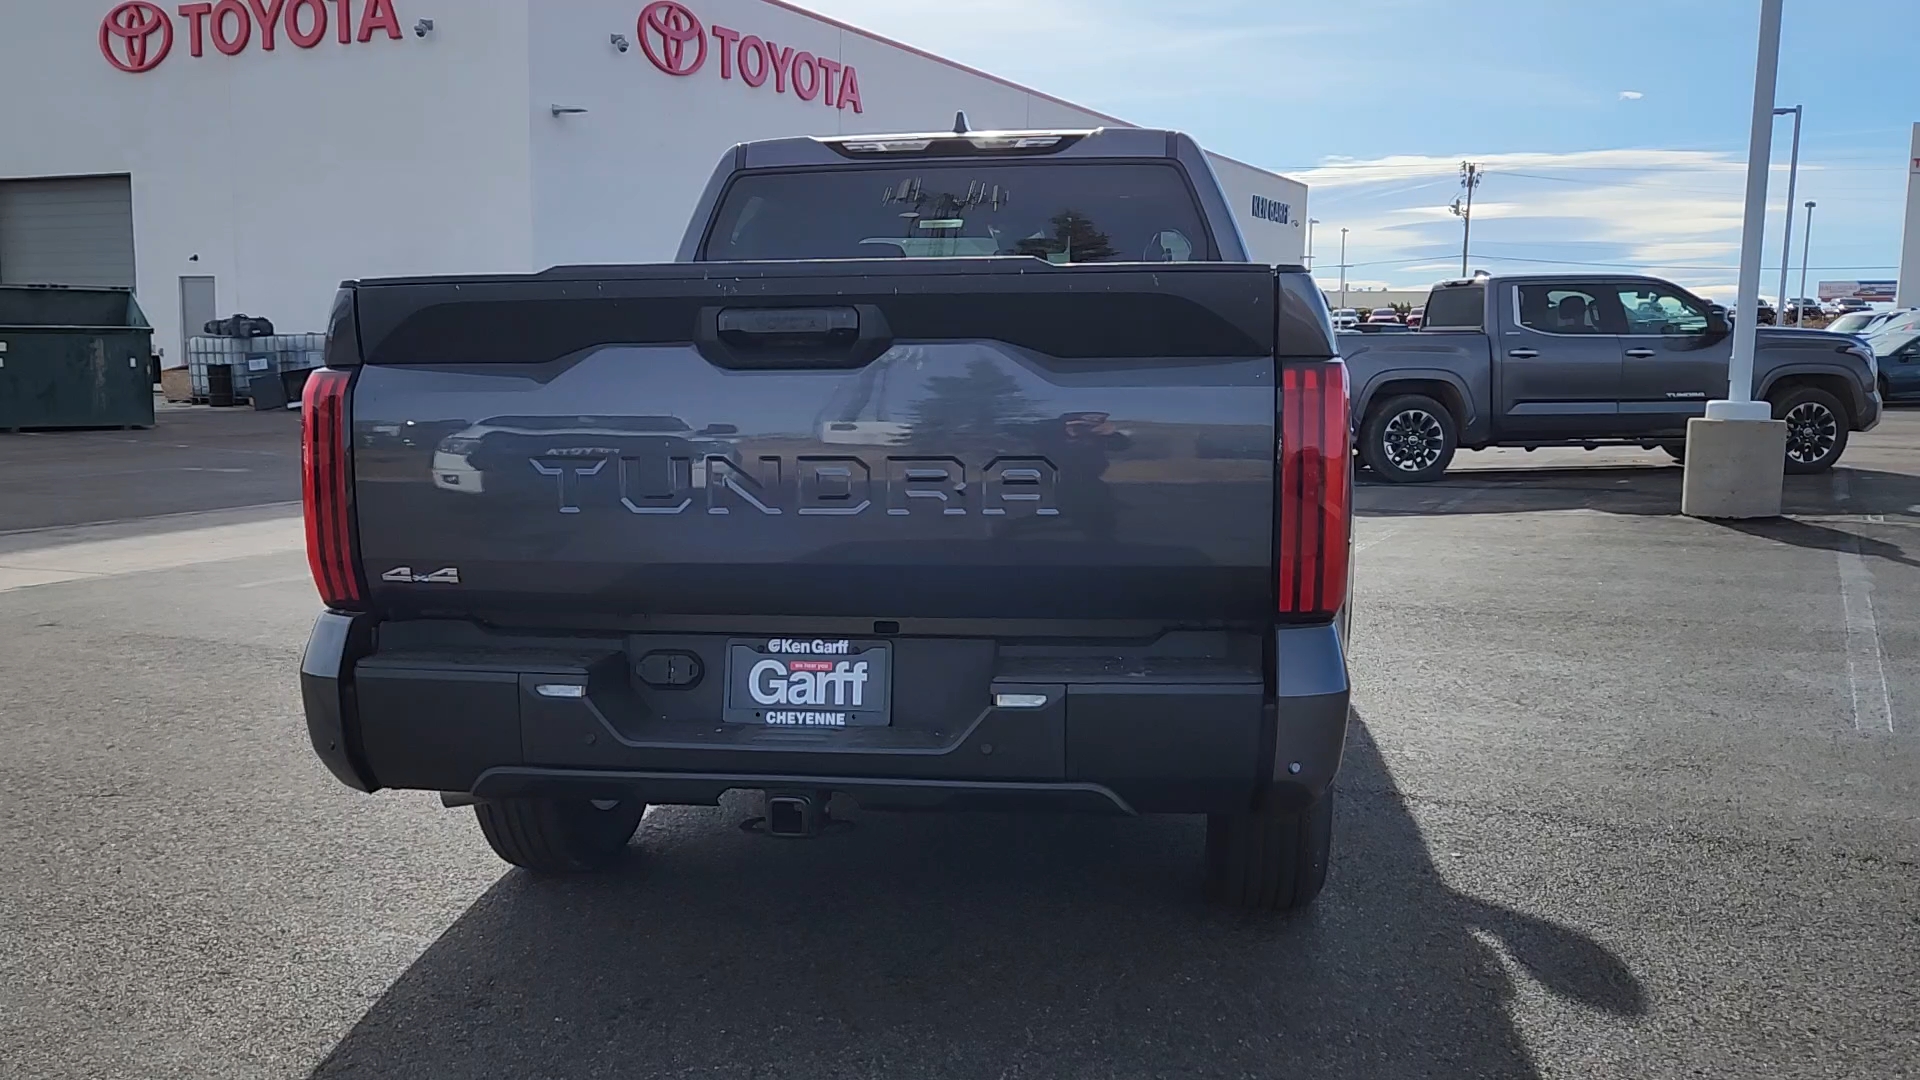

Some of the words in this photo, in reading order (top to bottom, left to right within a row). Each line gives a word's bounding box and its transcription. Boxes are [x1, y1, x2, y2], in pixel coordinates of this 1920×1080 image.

[178, 0, 403, 57] TOYOTA
[712, 25, 863, 113] TOYOTA
[1252, 194, 1267, 218] KEN
[529, 455, 1060, 515] TUNDRA
[782, 639, 812, 654] Ken
[812, 639, 849, 654] Garff
[749, 659, 868, 706] Garff
[765, 711, 846, 726] CHEYENNE
